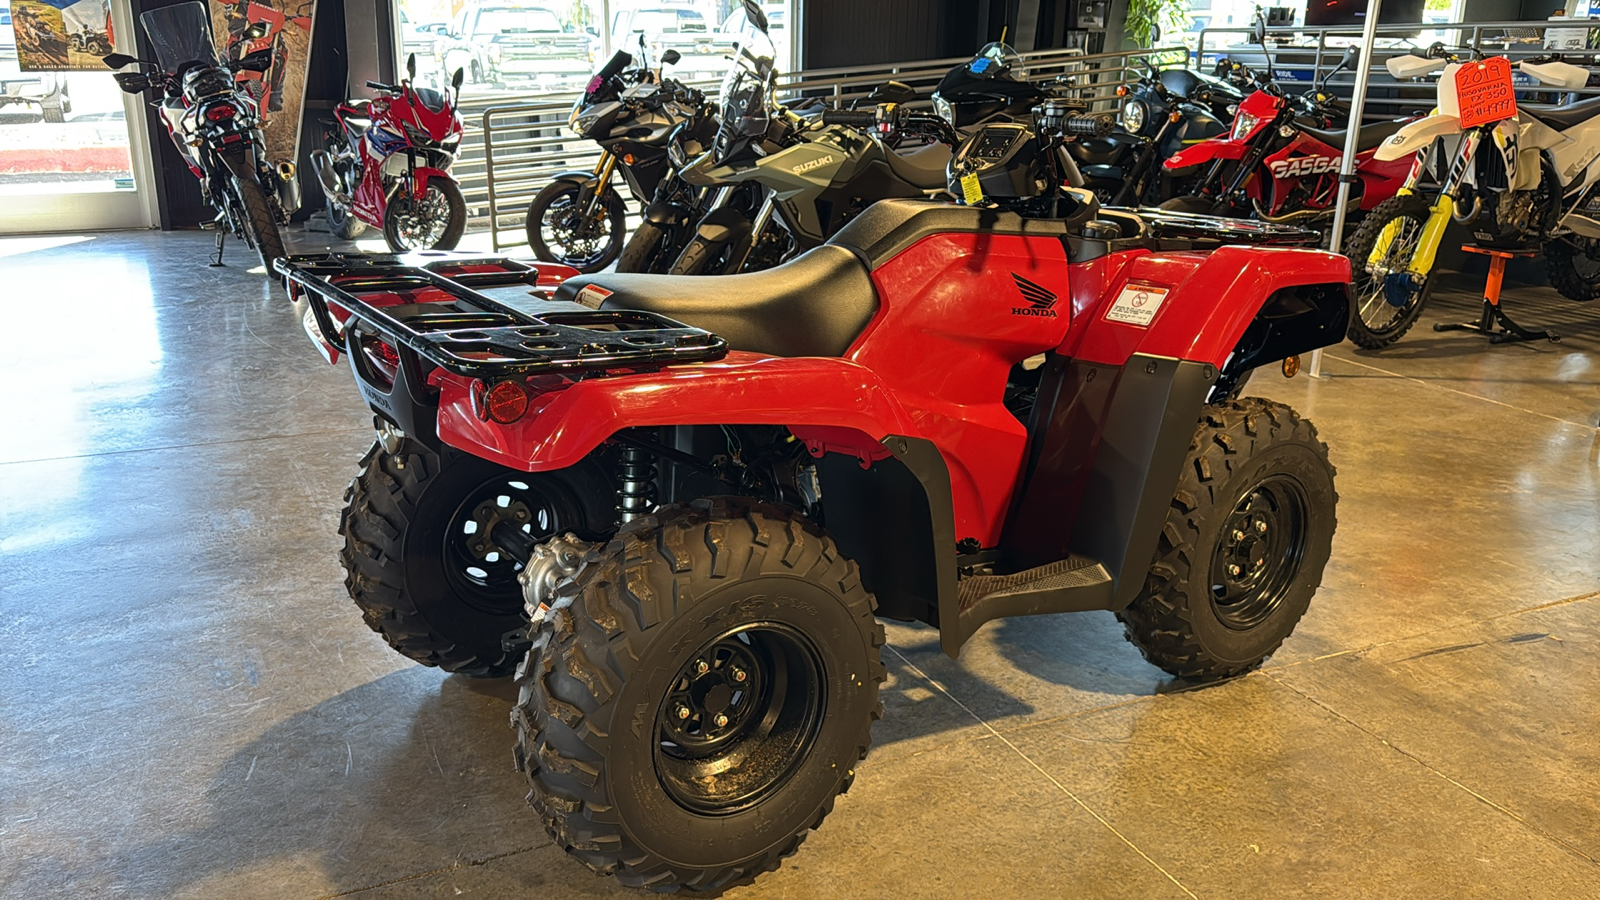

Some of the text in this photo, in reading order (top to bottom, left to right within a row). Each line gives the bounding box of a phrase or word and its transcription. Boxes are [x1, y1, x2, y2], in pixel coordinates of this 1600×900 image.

[1460, 65, 1501, 87] 2019
[1486, 88, 1507, 100] 350
[793, 155, 833, 174] SUZUKI
[353, 204, 378, 223] HONDA
[1011, 307, 1058, 317] HONDA
[363, 385, 393, 411] HONDA
